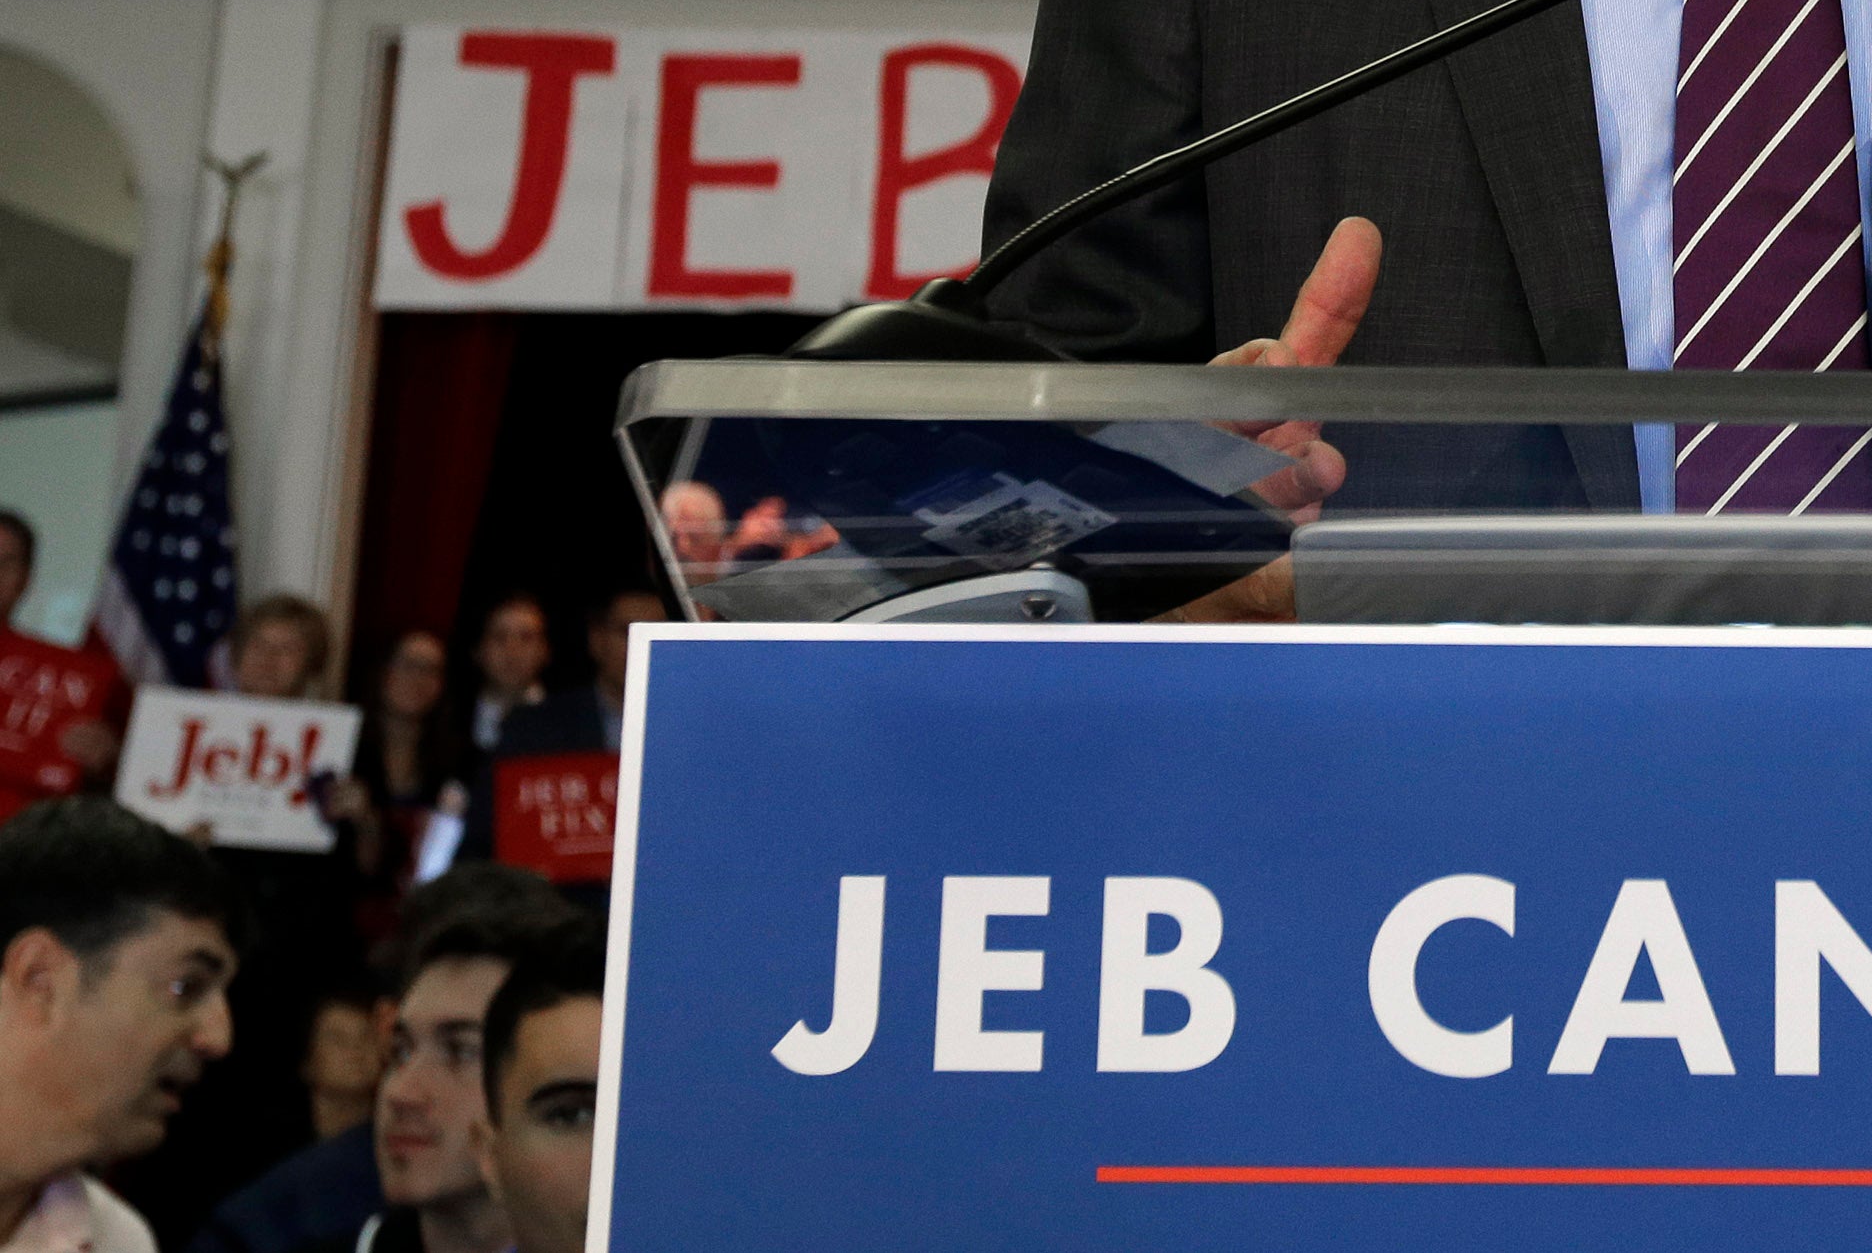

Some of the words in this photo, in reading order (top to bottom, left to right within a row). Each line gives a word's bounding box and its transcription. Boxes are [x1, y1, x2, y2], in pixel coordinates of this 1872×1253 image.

[405, 32, 1024, 302] JEB
[147, 717, 323, 809] Jeb!
[771, 874, 1236, 1077] JEB
